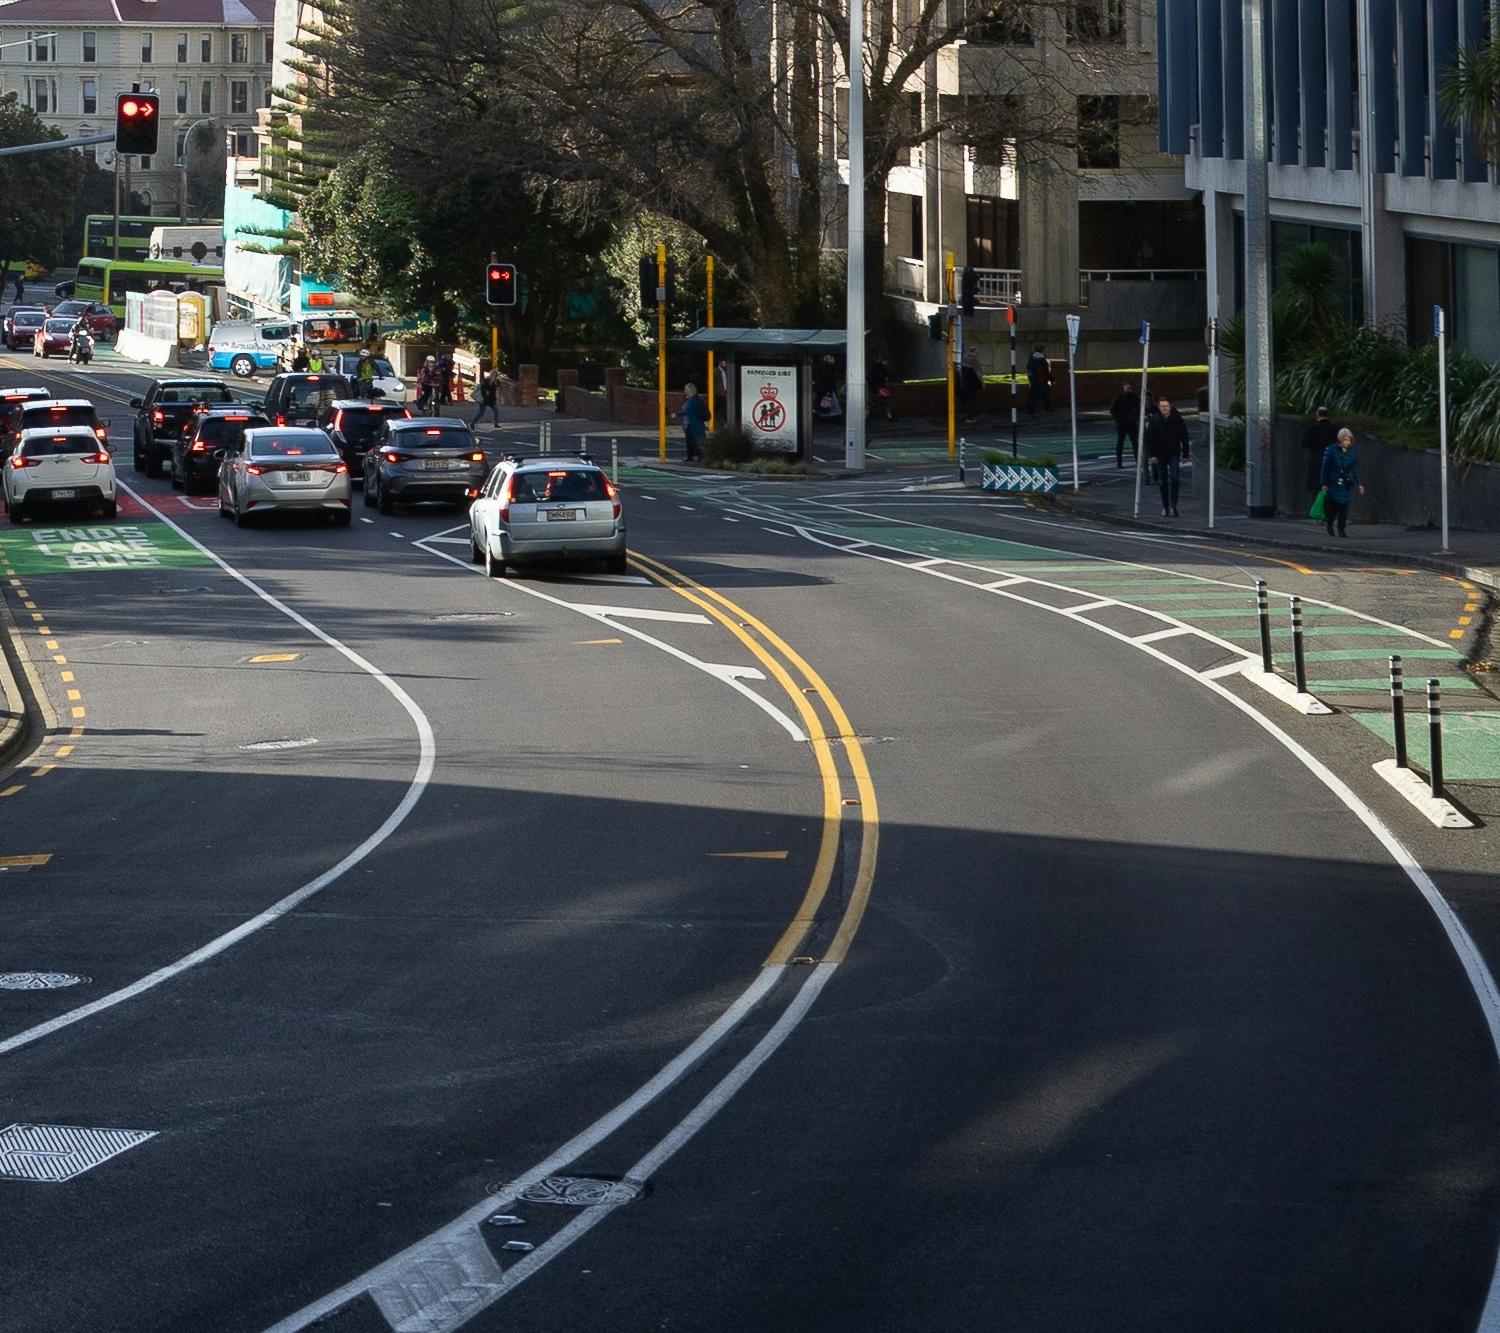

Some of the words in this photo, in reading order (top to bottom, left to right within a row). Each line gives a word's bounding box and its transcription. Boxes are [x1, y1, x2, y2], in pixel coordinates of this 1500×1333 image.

[31, 526, 149, 543] ENDS
[37, 539, 160, 556] LANE
[65, 552, 161, 569] BUS
